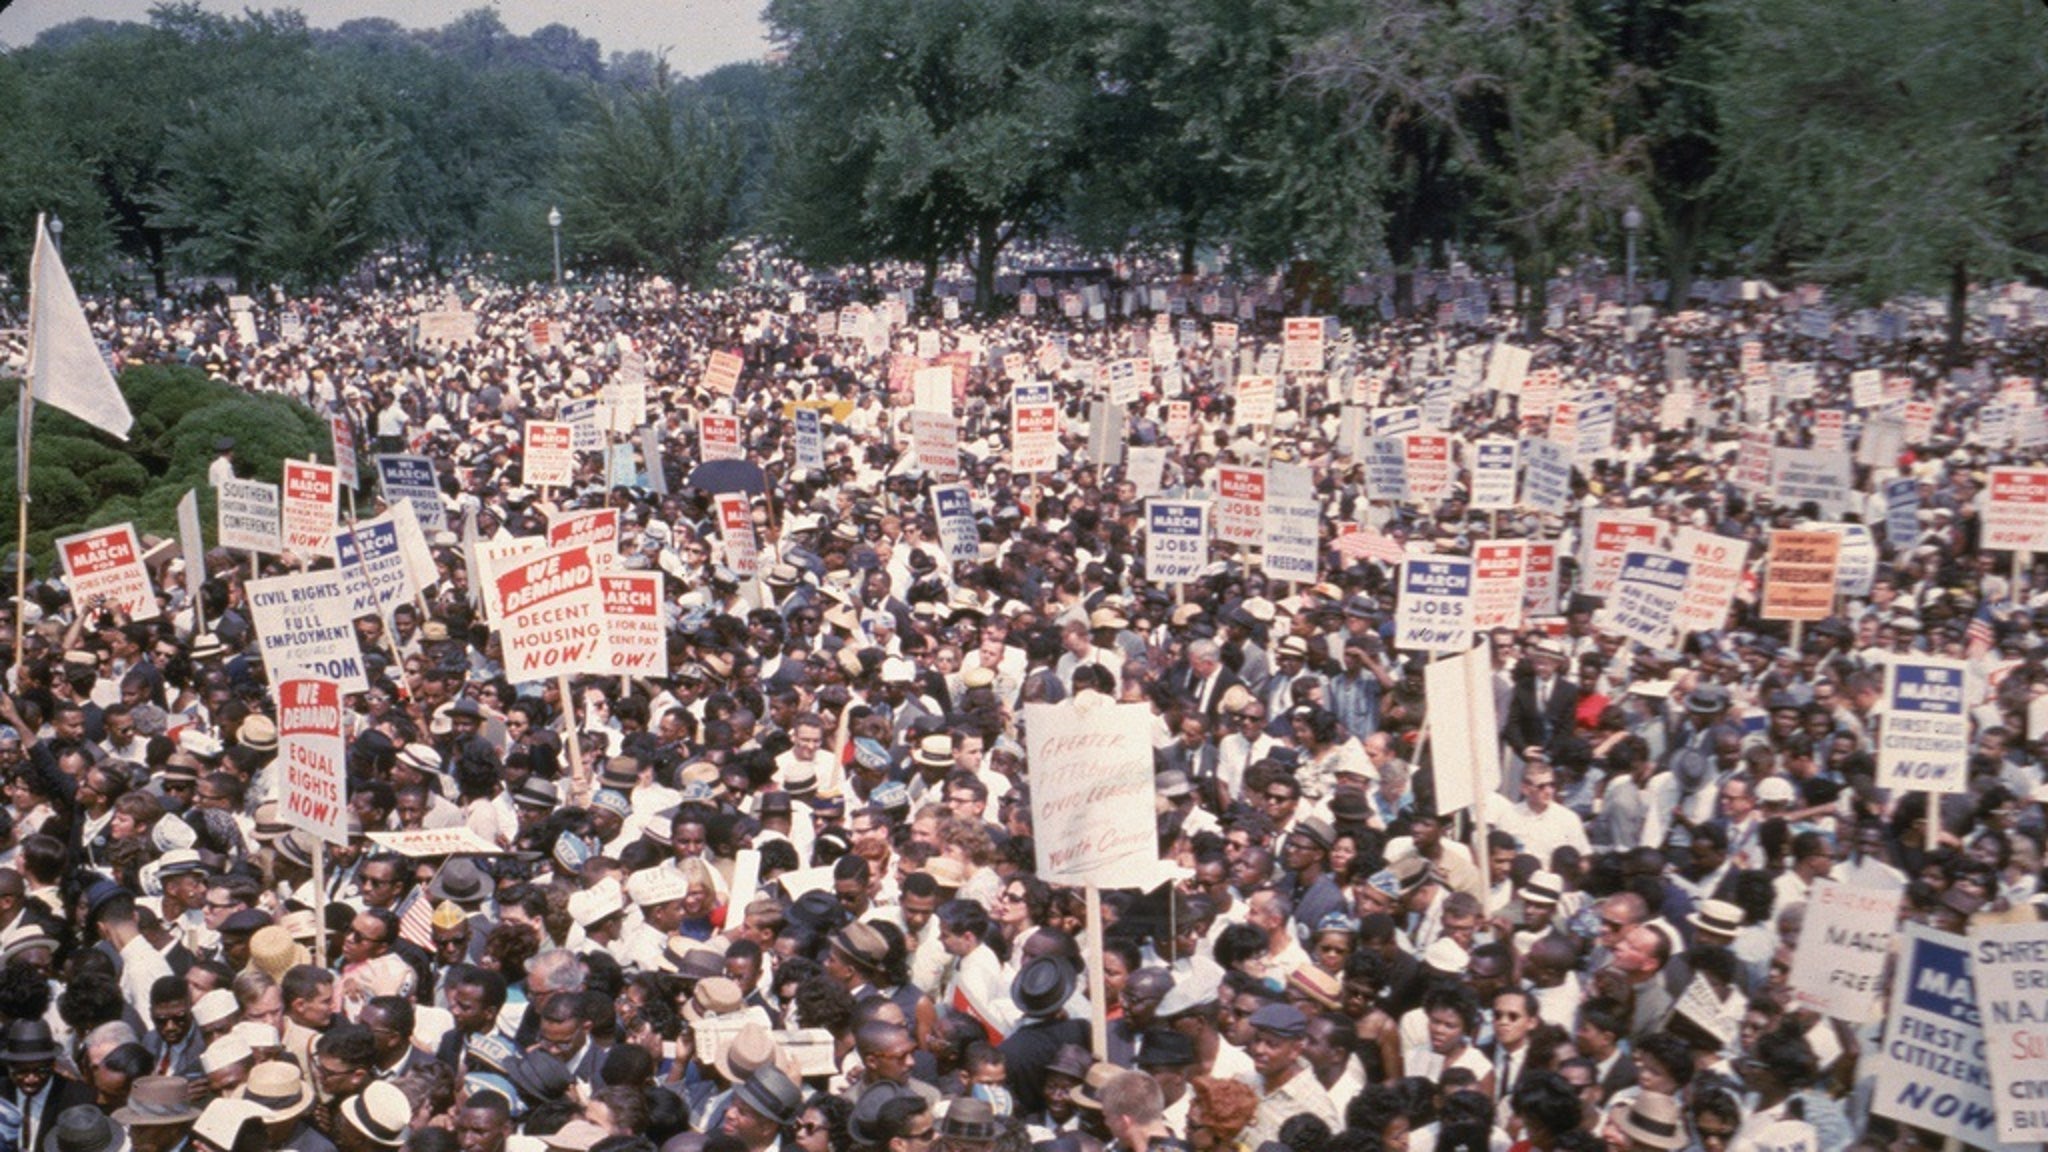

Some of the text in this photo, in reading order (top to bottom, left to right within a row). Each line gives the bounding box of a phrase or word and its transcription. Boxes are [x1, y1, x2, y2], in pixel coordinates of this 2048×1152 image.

[531, 433, 569, 443] MARCH
[705, 427, 735, 437] MARCH
[397, 461, 414, 469] WE
[301, 470, 317, 480] WE
[386, 468, 430, 481] MARCH
[1233, 473, 1249, 482] WE
[223, 481, 274, 503] SOUTHERN
[288, 478, 331, 495] MARCH
[1222, 480, 1262, 493] MARCH
[1167, 506, 1184, 516] WE
[1223, 502, 1262, 517] JOBS
[223, 514, 278, 536] CONFERENCE
[570, 515, 598, 534] WE
[1154, 515, 1199, 528] MARCH
[357, 528, 376, 541] WE
[1223, 525, 1264, 538] NOW!
[86, 537, 108, 551] WE
[289, 532, 331, 549] NOW!
[342, 533, 395, 559] MARCH
[952, 542, 979, 555] NO
[1155, 539, 1198, 553] JOBS
[73, 543, 130, 569] MARCH
[1696, 543, 1726, 561] NO
[342, 555, 403, 580] INTERATED
[525, 556, 561, 583] WE
[1154, 563, 1200, 578] NOW!
[1266, 553, 1315, 573] FREEDOM
[1429, 563, 1449, 574] WE
[101, 573, 120, 585] FOR
[609, 579, 632, 591] WE
[1410, 573, 1468, 588] MARCH
[1526, 575, 1548, 588] BS
[253, 583, 341, 607] CIVIL RIGHTS
[353, 583, 404, 610] NOW!
[506, 565, 590, 612] DEMAND
[602, 592, 653, 606] ARCH
[283, 603, 316, 616] PLUS
[609, 605, 635, 613] FOR
[1408, 601, 1464, 615] JOBS
[285, 615, 322, 631] FULL
[518, 604, 590, 629] DECENT
[1613, 612, 1666, 635] NOW!
[616, 620, 636, 631] FOR
[640, 620, 659, 632] ALL
[265, 625, 350, 649] EMPLOYMENT
[513, 623, 601, 650] HOUSING
[608, 635, 659, 646] CENT PAY
[1405, 627, 1465, 644] NOW!
[523, 639, 598, 670] NOW!
[611, 652, 657, 668] OW!
[1924, 669, 1949, 683] WE
[296, 683, 320, 705] WE
[1898, 682, 1962, 702] MARCH
[283, 705, 338, 731] DEMAND
[289, 742, 335, 777] EQUAL
[1892, 760, 1960, 780] NOW!
[288, 768, 337, 802] RIGHTS
[288, 791, 339, 827] NOW!
[1900, 1015, 1966, 1046] FIRST
